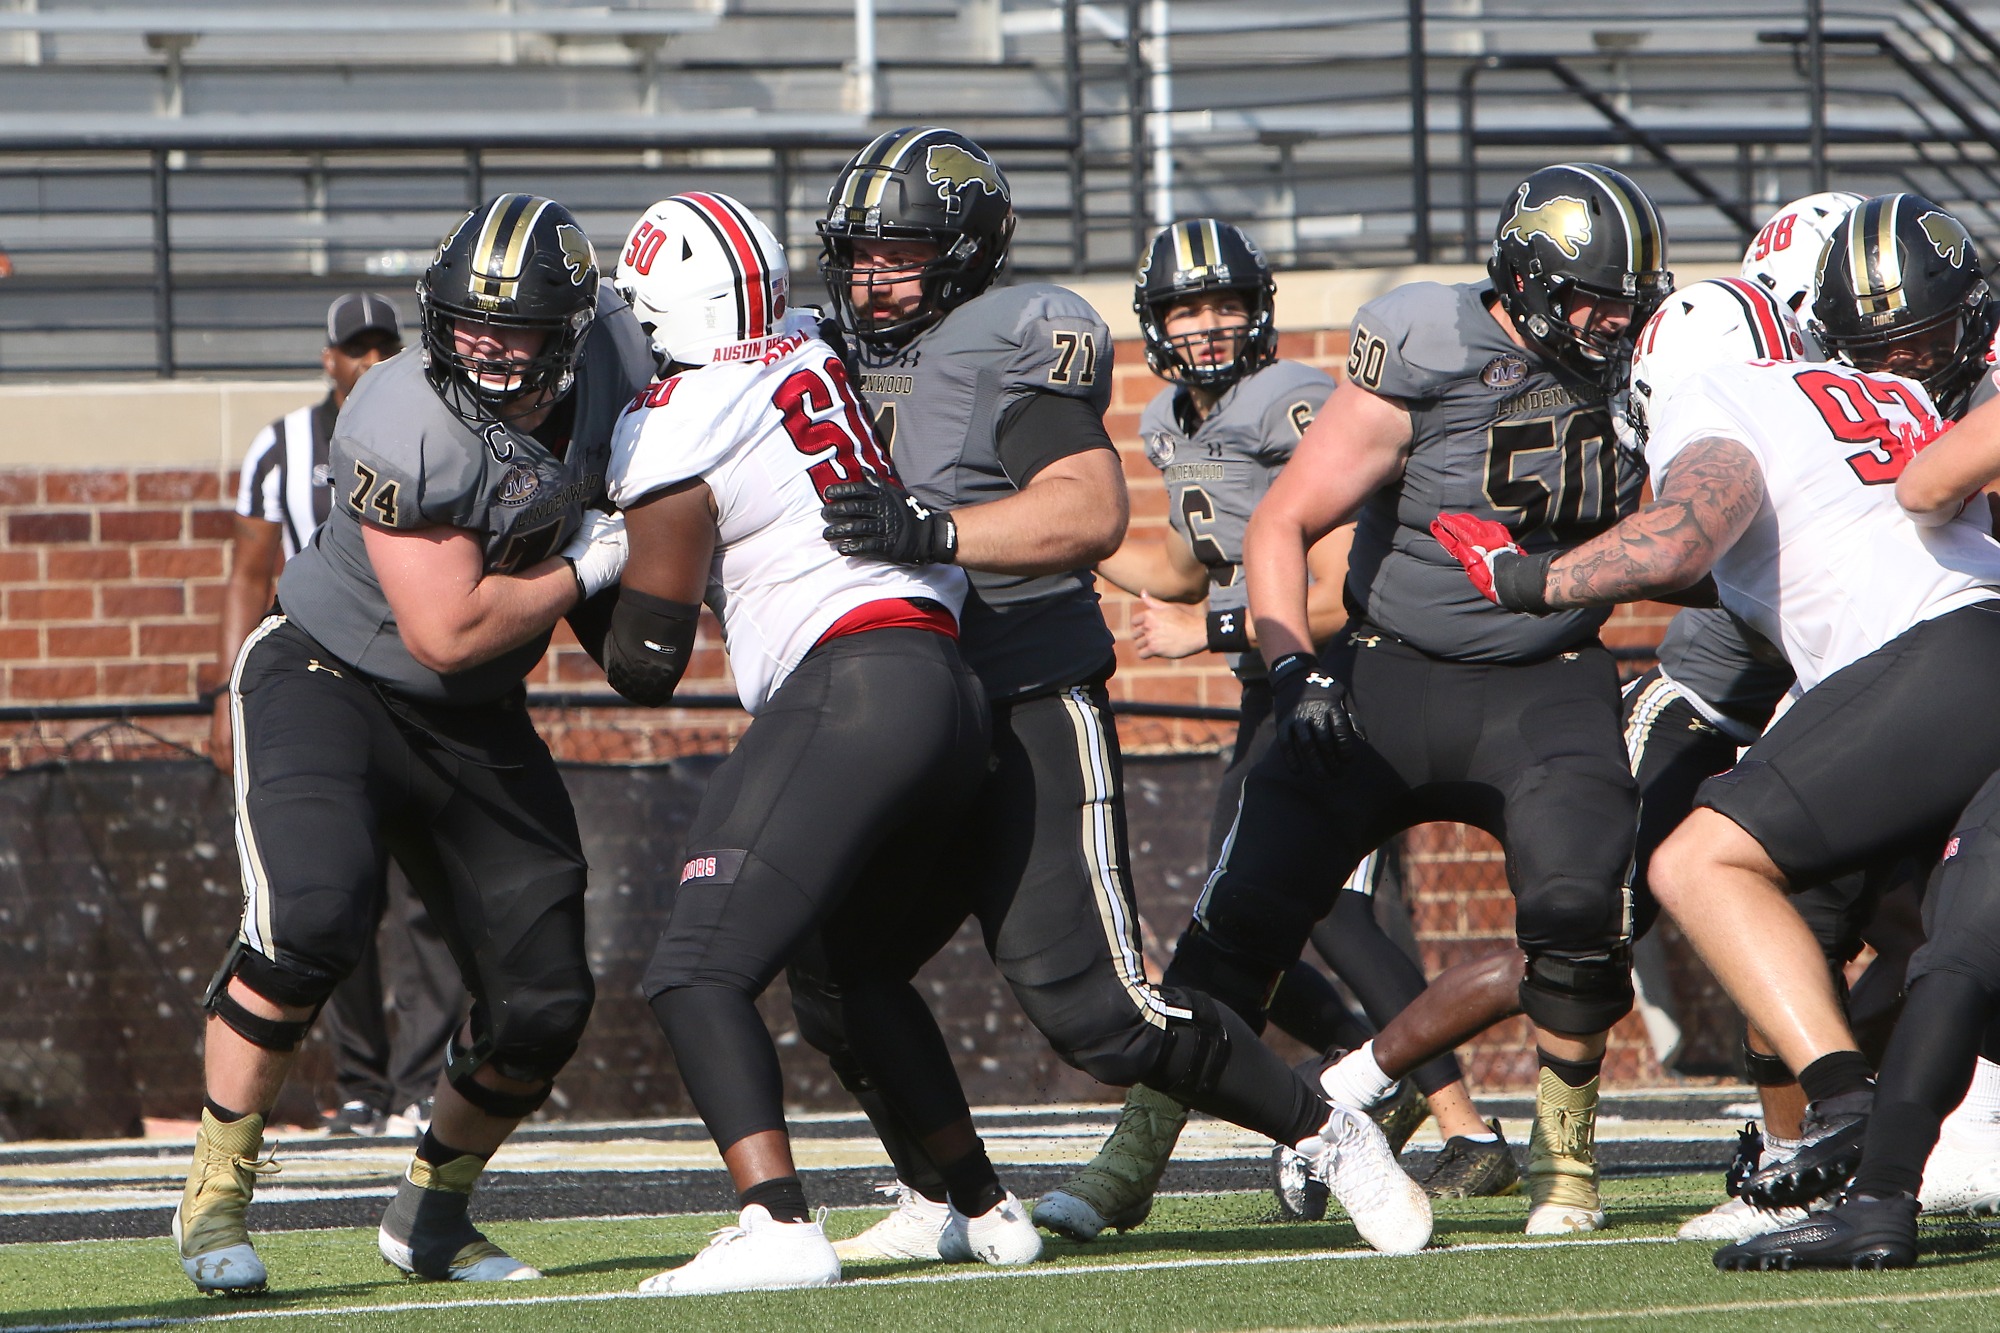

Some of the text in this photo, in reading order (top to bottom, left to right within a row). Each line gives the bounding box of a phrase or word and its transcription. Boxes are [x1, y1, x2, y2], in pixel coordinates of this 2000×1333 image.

[624, 220, 667, 276] 50
[1755, 213, 1798, 261] 98
[1872, 312, 1895, 327] LIONS
[712, 340, 761, 363] AUSTIN
[1048, 330, 1096, 385] 71
[1346, 323, 1388, 390] 50
[1491, 363, 1521, 384] OVC
[484, 422, 515, 465] C
[1792, 369, 1929, 486] 97
[349, 459, 401, 527] 74
[1482, 407, 1621, 542] 50
[1181, 485, 1238, 588] 6
